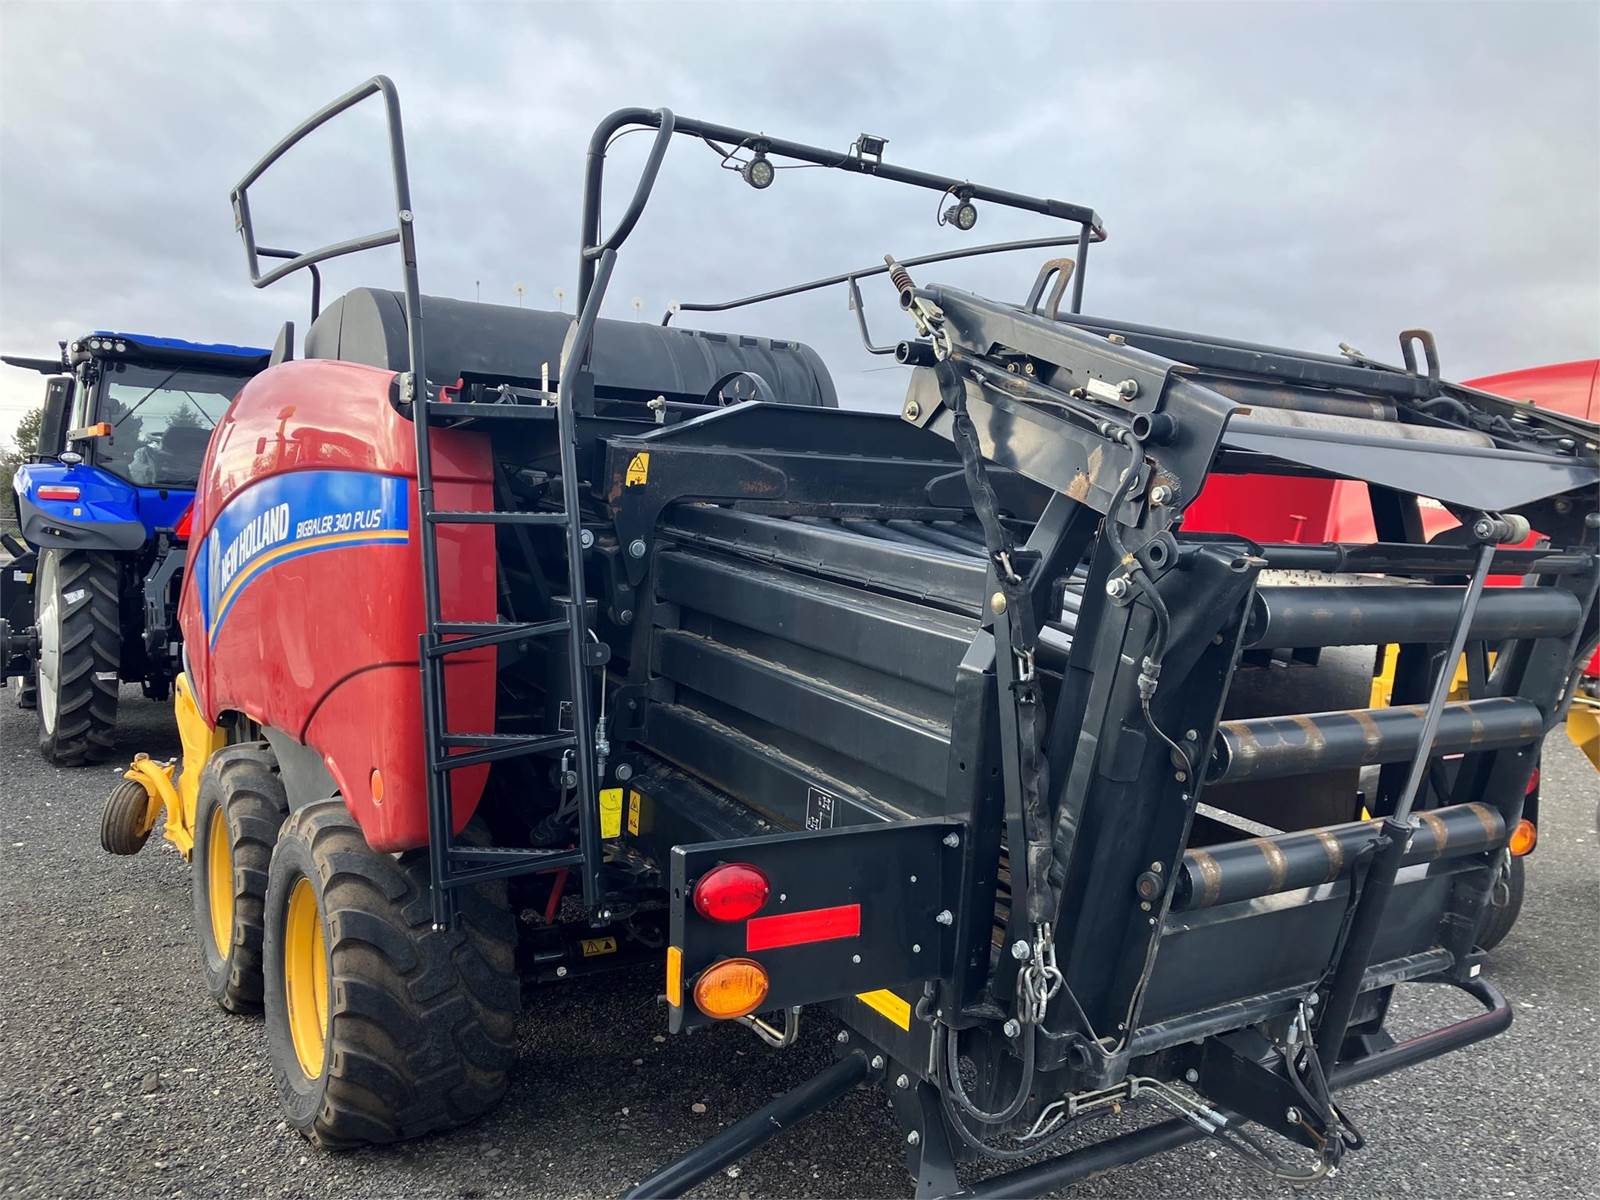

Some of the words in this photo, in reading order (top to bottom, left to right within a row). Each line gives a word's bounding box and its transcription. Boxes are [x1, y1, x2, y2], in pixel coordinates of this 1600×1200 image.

[221, 536, 239, 592] NEW
[239, 502, 290, 567] HOLLAND
[296, 515, 333, 538] BIGBALER
[333, 513, 352, 532] 340
[353, 508, 382, 530] PLUS
